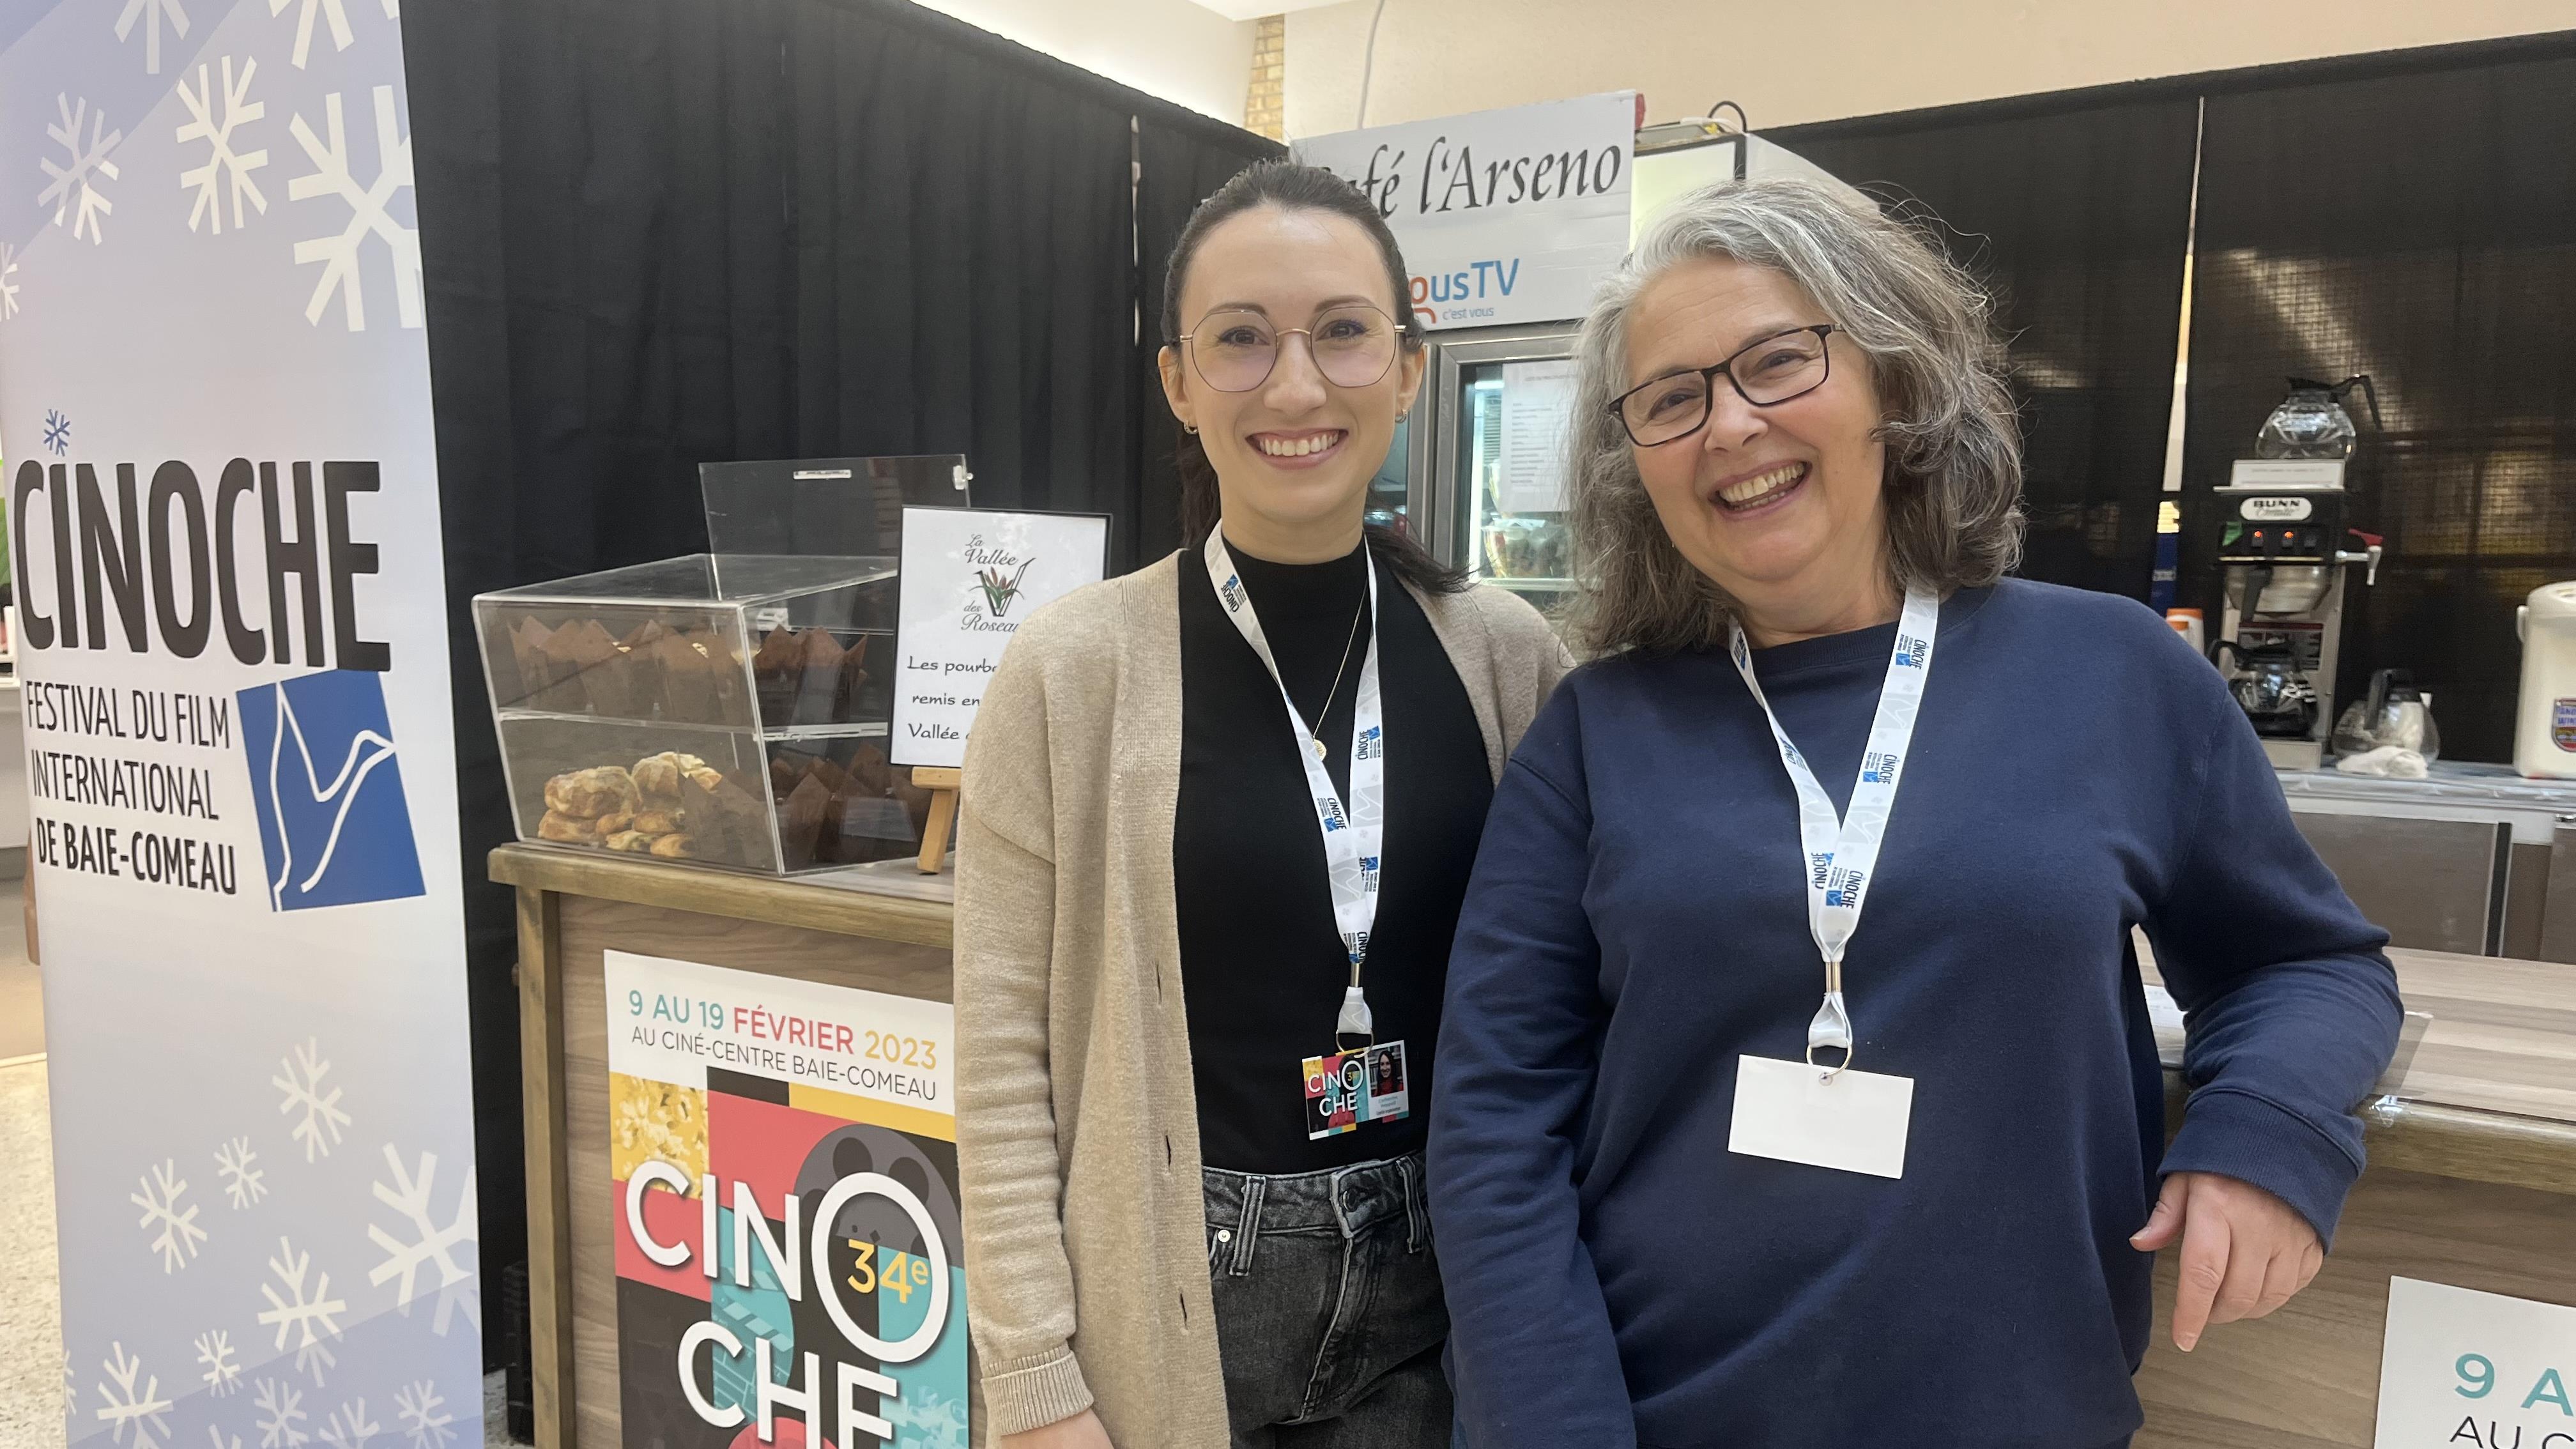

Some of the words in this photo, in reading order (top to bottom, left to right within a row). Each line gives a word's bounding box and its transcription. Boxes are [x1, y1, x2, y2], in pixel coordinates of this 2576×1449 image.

[1409, 258, 1520, 304] ousTV
[1443, 308, 1466, 320] c'est
[1469, 307, 1494, 318] vous
[965, 534, 984, 548] La
[965, 548, 1018, 565] Vallée
[14, 458, 390, 671] CINOCHE
[963, 600, 982, 612] des
[907, 656, 939, 670] Les
[26, 680, 126, 739] FESTIVAL
[132, 690, 169, 742] DU
[175, 694, 230, 748] FILM
[912, 693, 956, 705] remis
[908, 723, 960, 739] Vallée
[1357, 730, 1370, 760] CINOCHE
[31, 749, 219, 820] INTERNATIONAL
[1878, 754, 1897, 785] CINOCHE
[1328, 797, 1347, 830] CINOCHE
[36, 817, 59, 867] DE
[64, 822, 236, 895] BAIE-COMEAU
[1840, 870, 1864, 909] CINOCHE
[1357, 931, 1368, 963] CINOC
[629, 990, 643, 1016] 9
[653, 995, 691, 1025] AU
[699, 1001, 723, 1030] 19
[734, 1004, 854, 1055] FÉVRIER
[864, 1030, 937, 1070] 2023
[631, 1027, 657, 1046] AU
[662, 1031, 787, 1072] CINÉ-CENTRE
[792, 1057, 937, 1101] BAIE-COMEAU
[1308, 1060, 1363, 1093] CINO
[1319, 1092, 1358, 1117] CHE
[625, 1159, 949, 1363] CINO
[847, 1239, 929, 1303] 34e
[678, 1321, 898, 1449] CHE
[2455, 1354, 2495, 1399] 9
[2520, 1368, 2575, 1417] A
[2450, 1416, 2521, 1449] AU
